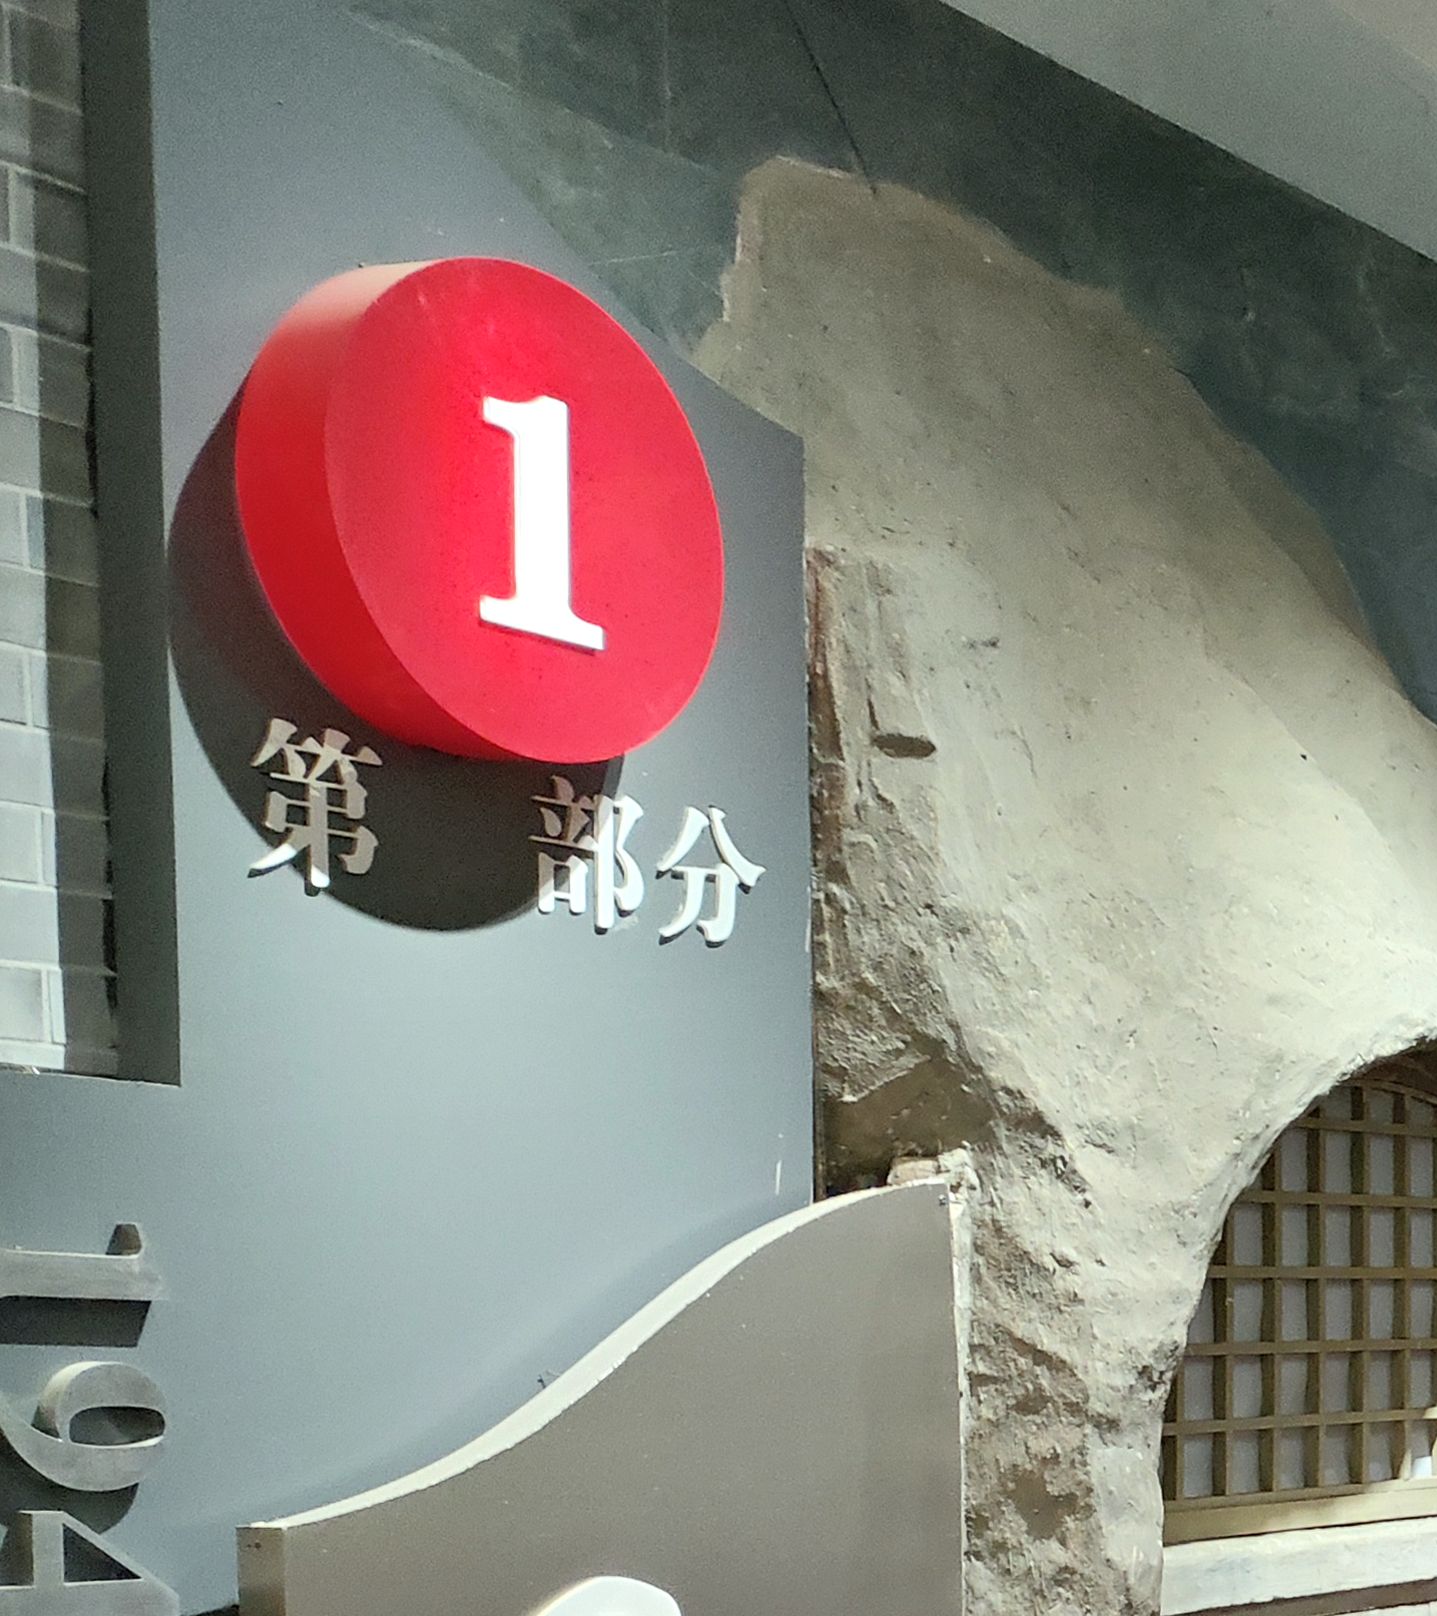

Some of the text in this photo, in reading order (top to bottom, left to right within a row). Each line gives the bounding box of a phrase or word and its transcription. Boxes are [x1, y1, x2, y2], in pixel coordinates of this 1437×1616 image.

[478, 394, 606, 652] 1
[248, 717, 767, 945] 第 部分
